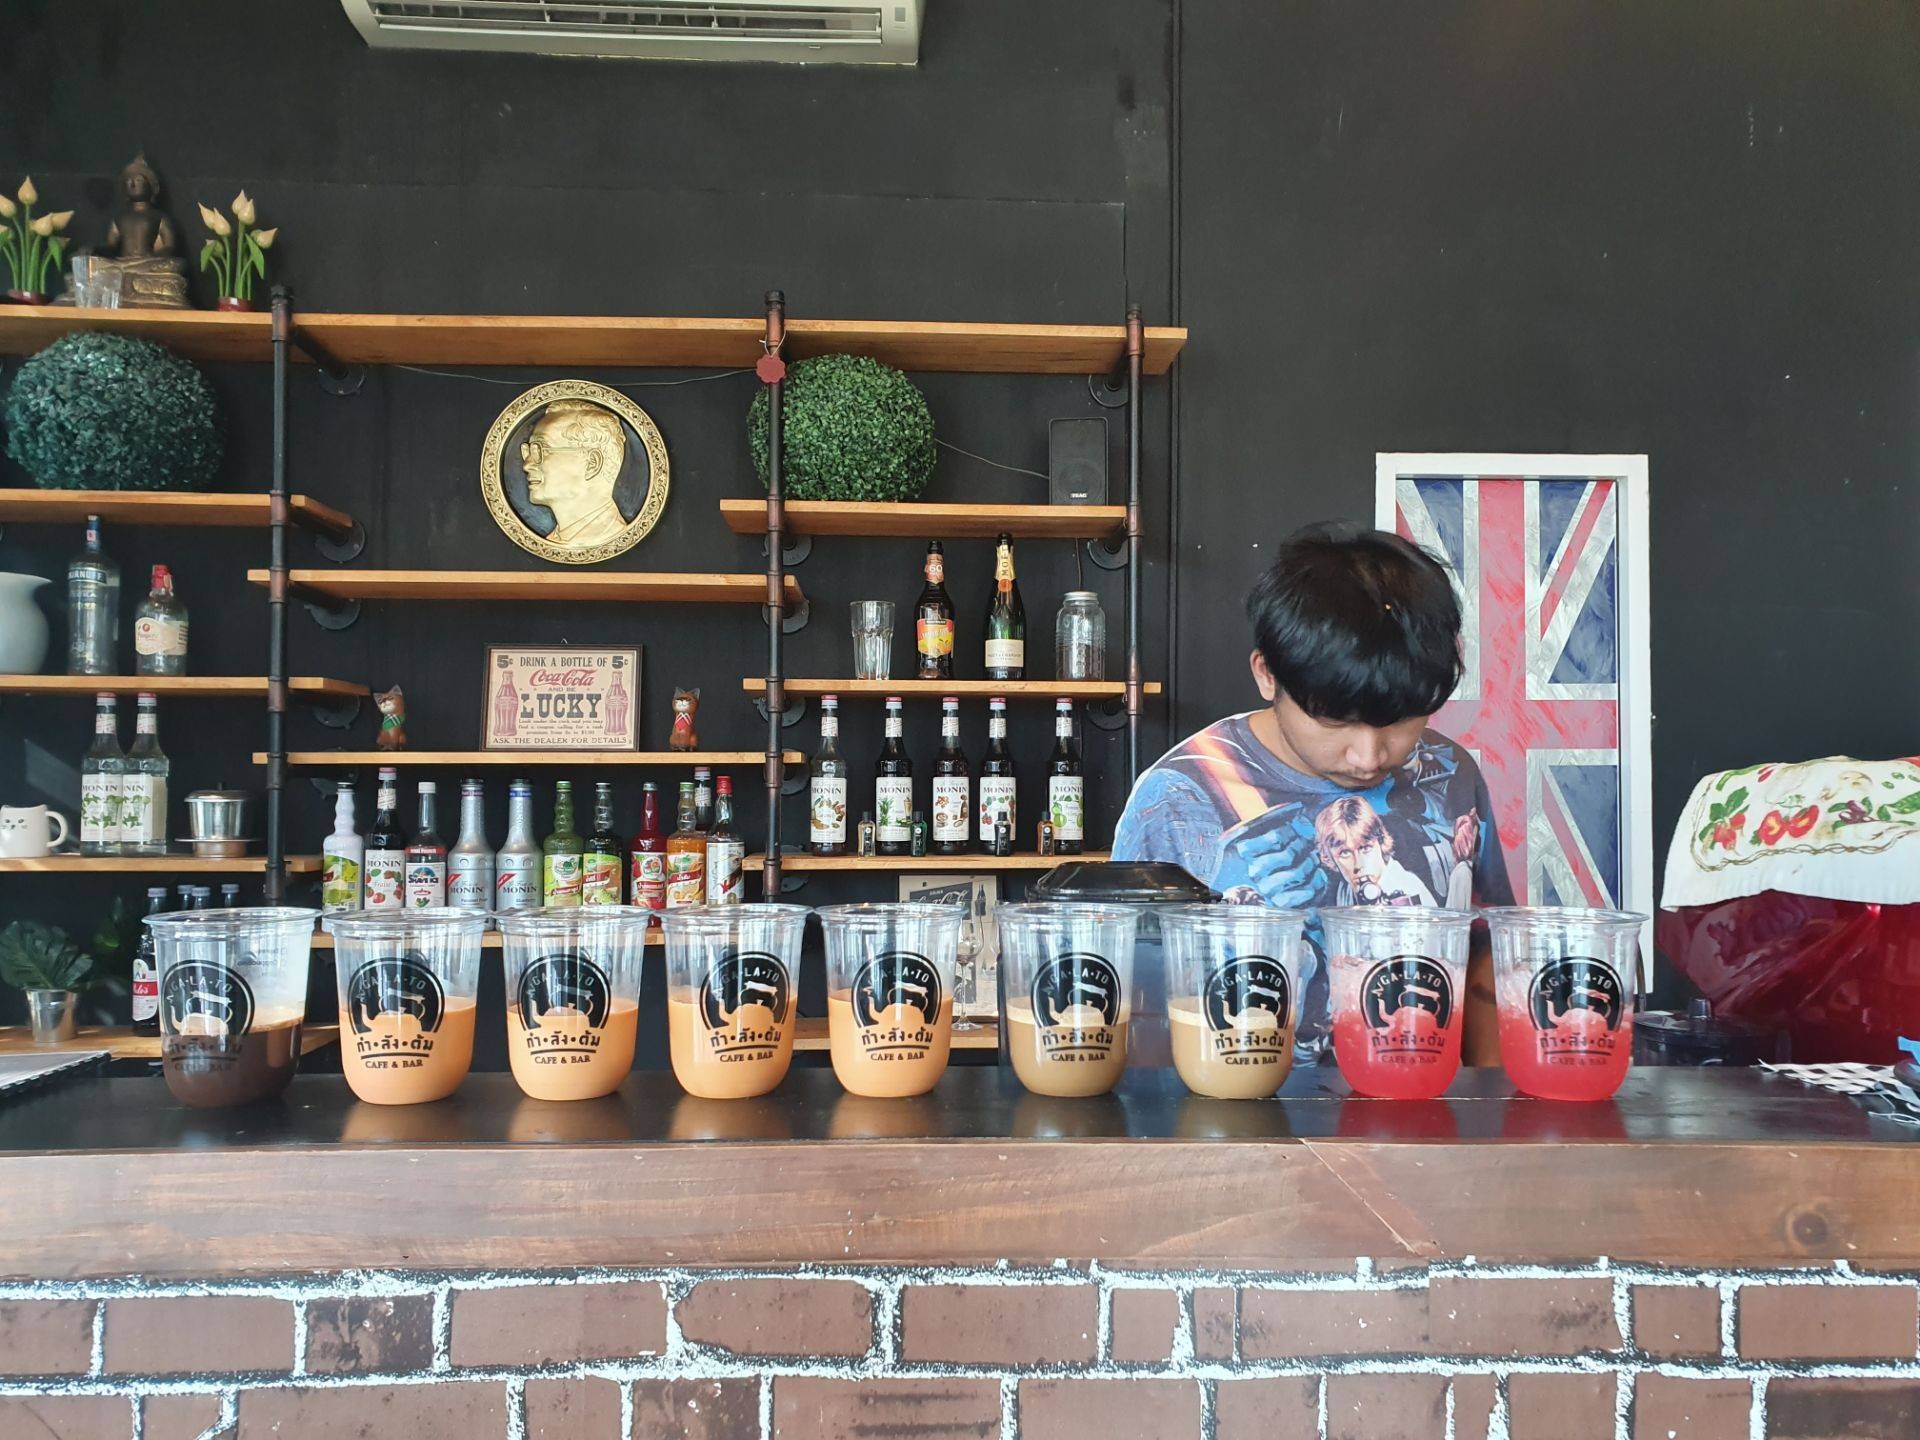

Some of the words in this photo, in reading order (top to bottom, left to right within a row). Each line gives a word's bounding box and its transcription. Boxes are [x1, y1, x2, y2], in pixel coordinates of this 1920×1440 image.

[520, 656, 547, 667] DRINK
[551, 656, 557, 667] A
[561, 656, 593, 667] BOTTLE
[597, 656, 608, 667] OF
[520, 693, 602, 718] LUCKY
[1055, 785, 1083, 793] MONIN
[448, 886, 484, 894] MONIN
[503, 886, 537, 894] MONIN
[535, 1056, 557, 1064] CAFE
[571, 1055, 591, 1063] BAR
[720, 1053, 744, 1062] CAFE
[756, 1051, 773, 1060] BAR
[871, 1053, 894, 1061] CAFE
[907, 1052, 924, 1060] BAR
[1051, 1053, 1076, 1062] CAFE
[1088, 1052, 1105, 1060] BAR
[1225, 1057, 1250, 1065] CAFE
[1262, 1056, 1278, 1064] BAR
[1382, 1056, 1406, 1064] CAFE
[1420, 1056, 1437, 1064] BAR
[365, 1061, 388, 1069] CAFE
[391, 1061, 398, 1069] &
[403, 1060, 423, 1068] BAR
